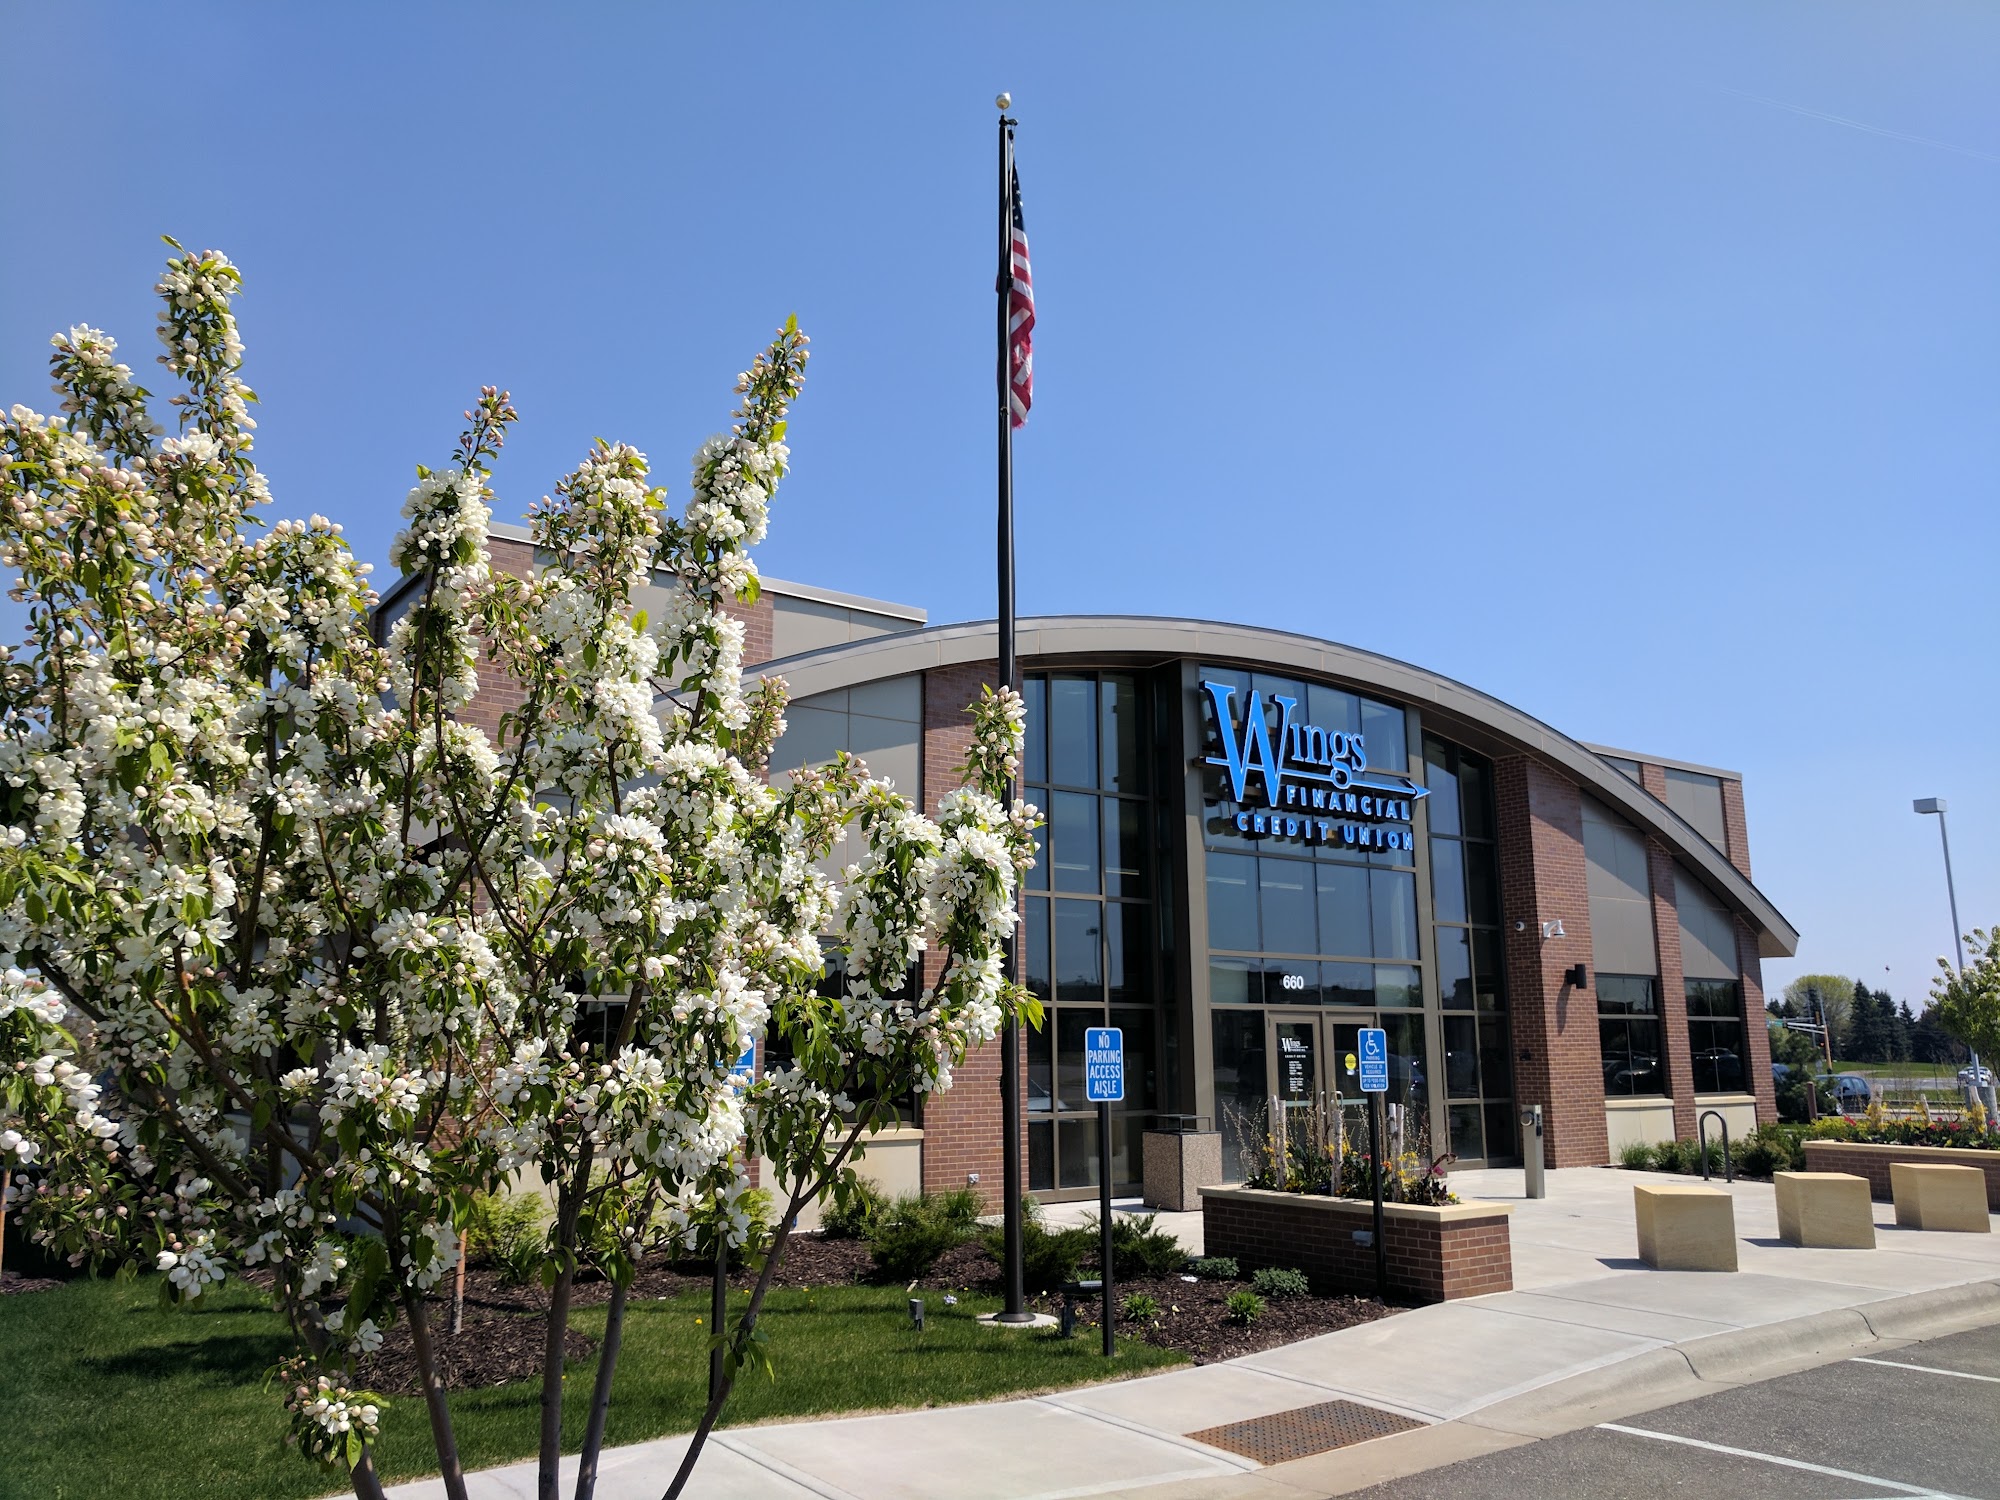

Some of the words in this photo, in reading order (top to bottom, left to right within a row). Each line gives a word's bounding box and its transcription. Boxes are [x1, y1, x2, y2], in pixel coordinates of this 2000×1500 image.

[1204, 680, 1368, 807] Wings
[1286, 784, 1411, 821] FINANCIAL
[1236, 813, 1329, 841] CREDIT
[1343, 825, 1414, 851] UNION
[1283, 975, 1304, 990] 660
[1098, 1034, 1110, 1049] NO
[1088, 1049, 1121, 1064] PARKING
[1089, 1065, 1120, 1079] ACCESS
[1093, 1080, 1117, 1094] AISLE
